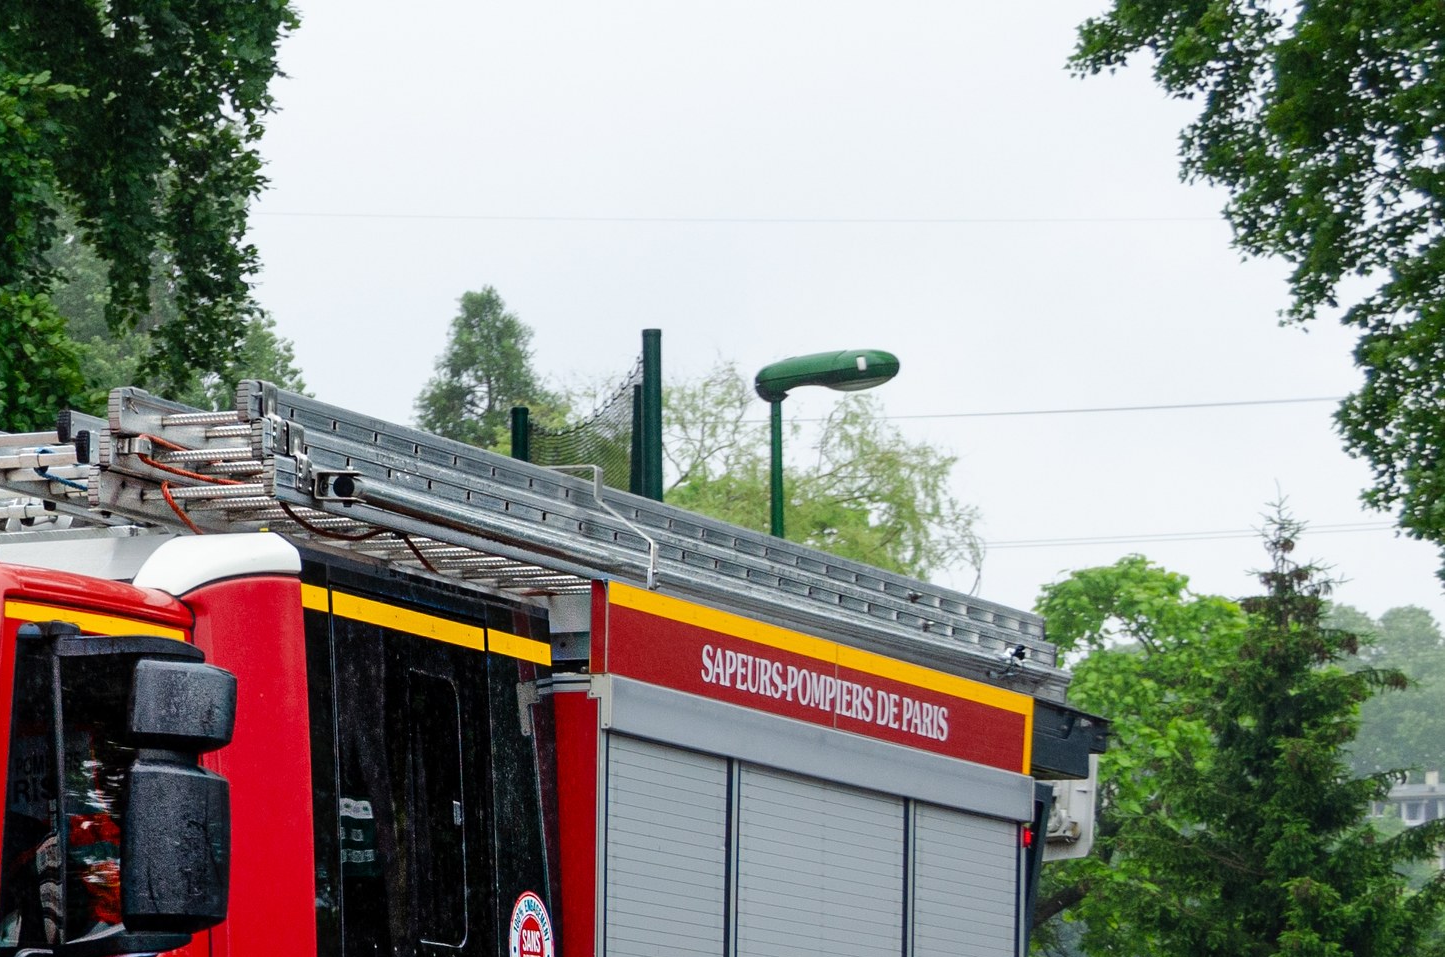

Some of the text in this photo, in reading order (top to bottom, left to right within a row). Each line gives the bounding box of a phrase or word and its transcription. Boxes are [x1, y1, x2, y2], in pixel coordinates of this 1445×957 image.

[701, 644, 948, 741] SAPEURS-POMPIERS DE PARIS
[522, 929, 540, 952] SANS
